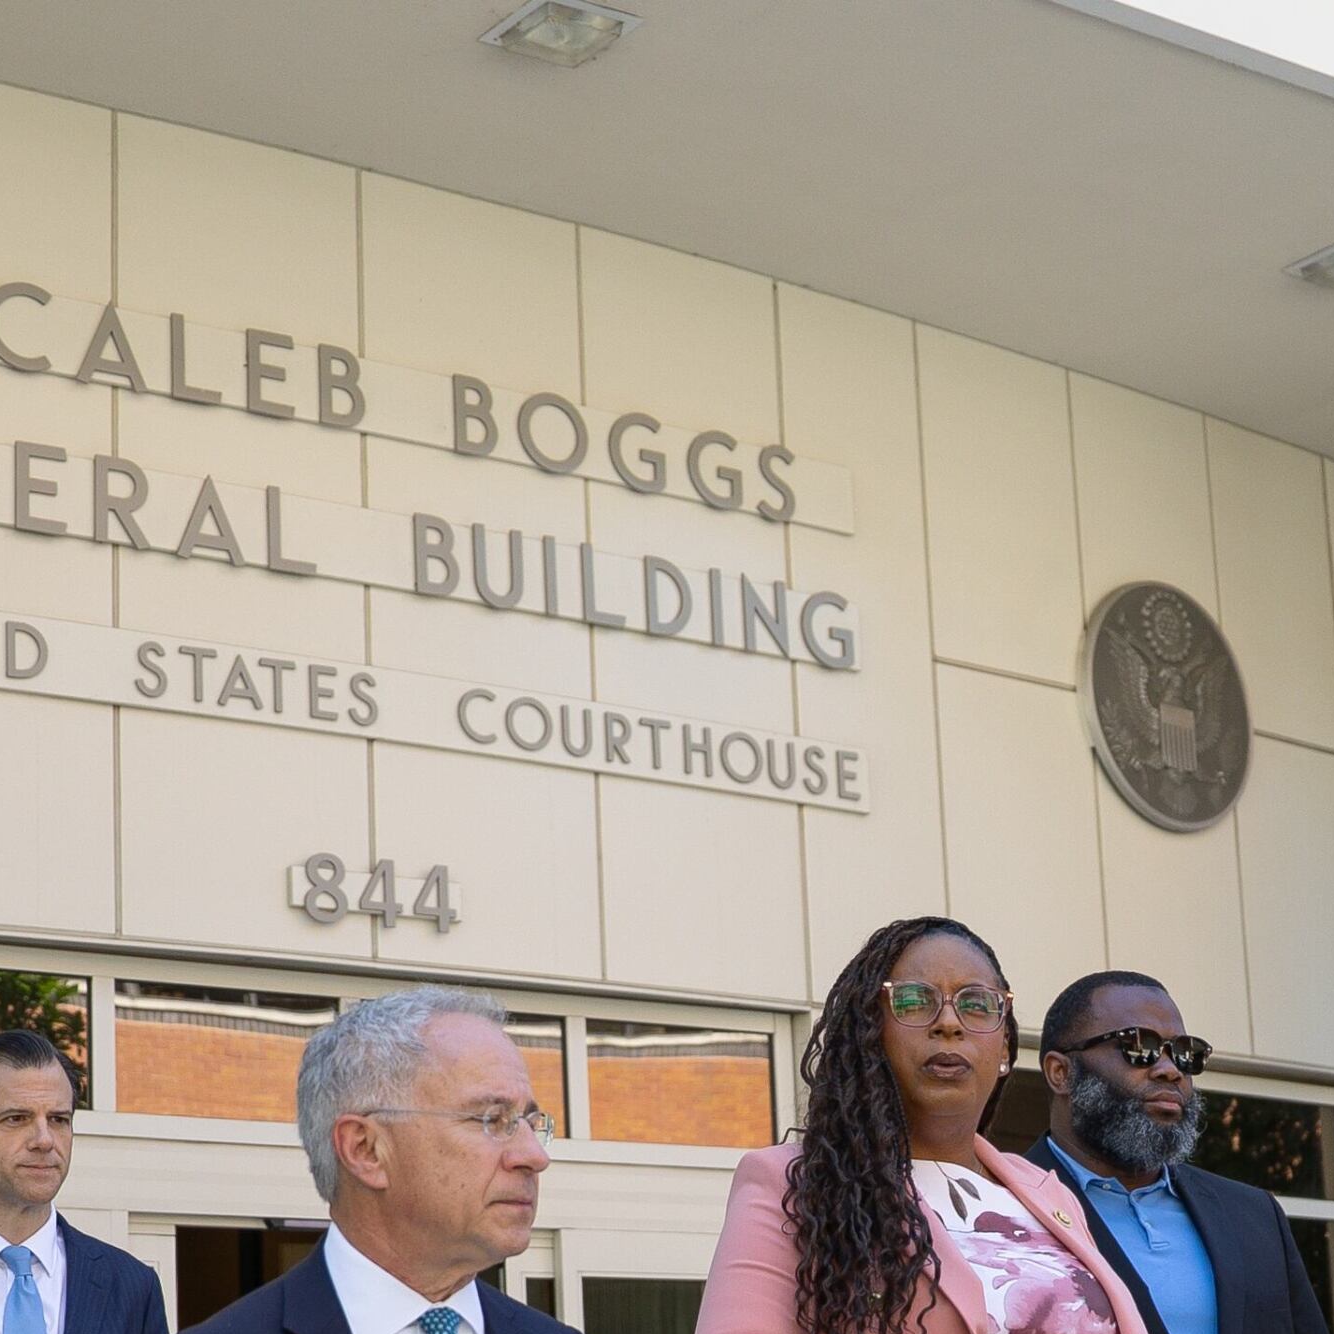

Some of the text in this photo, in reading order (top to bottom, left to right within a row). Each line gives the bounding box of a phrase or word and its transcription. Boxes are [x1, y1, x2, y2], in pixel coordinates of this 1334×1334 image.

[452, 373, 797, 525] BOGGS
[413, 512, 857, 670] BUILDING
[133, 641, 379, 728] STATES
[457, 688, 861, 802] COURTHOUSE
[302, 852, 458, 933] 844
